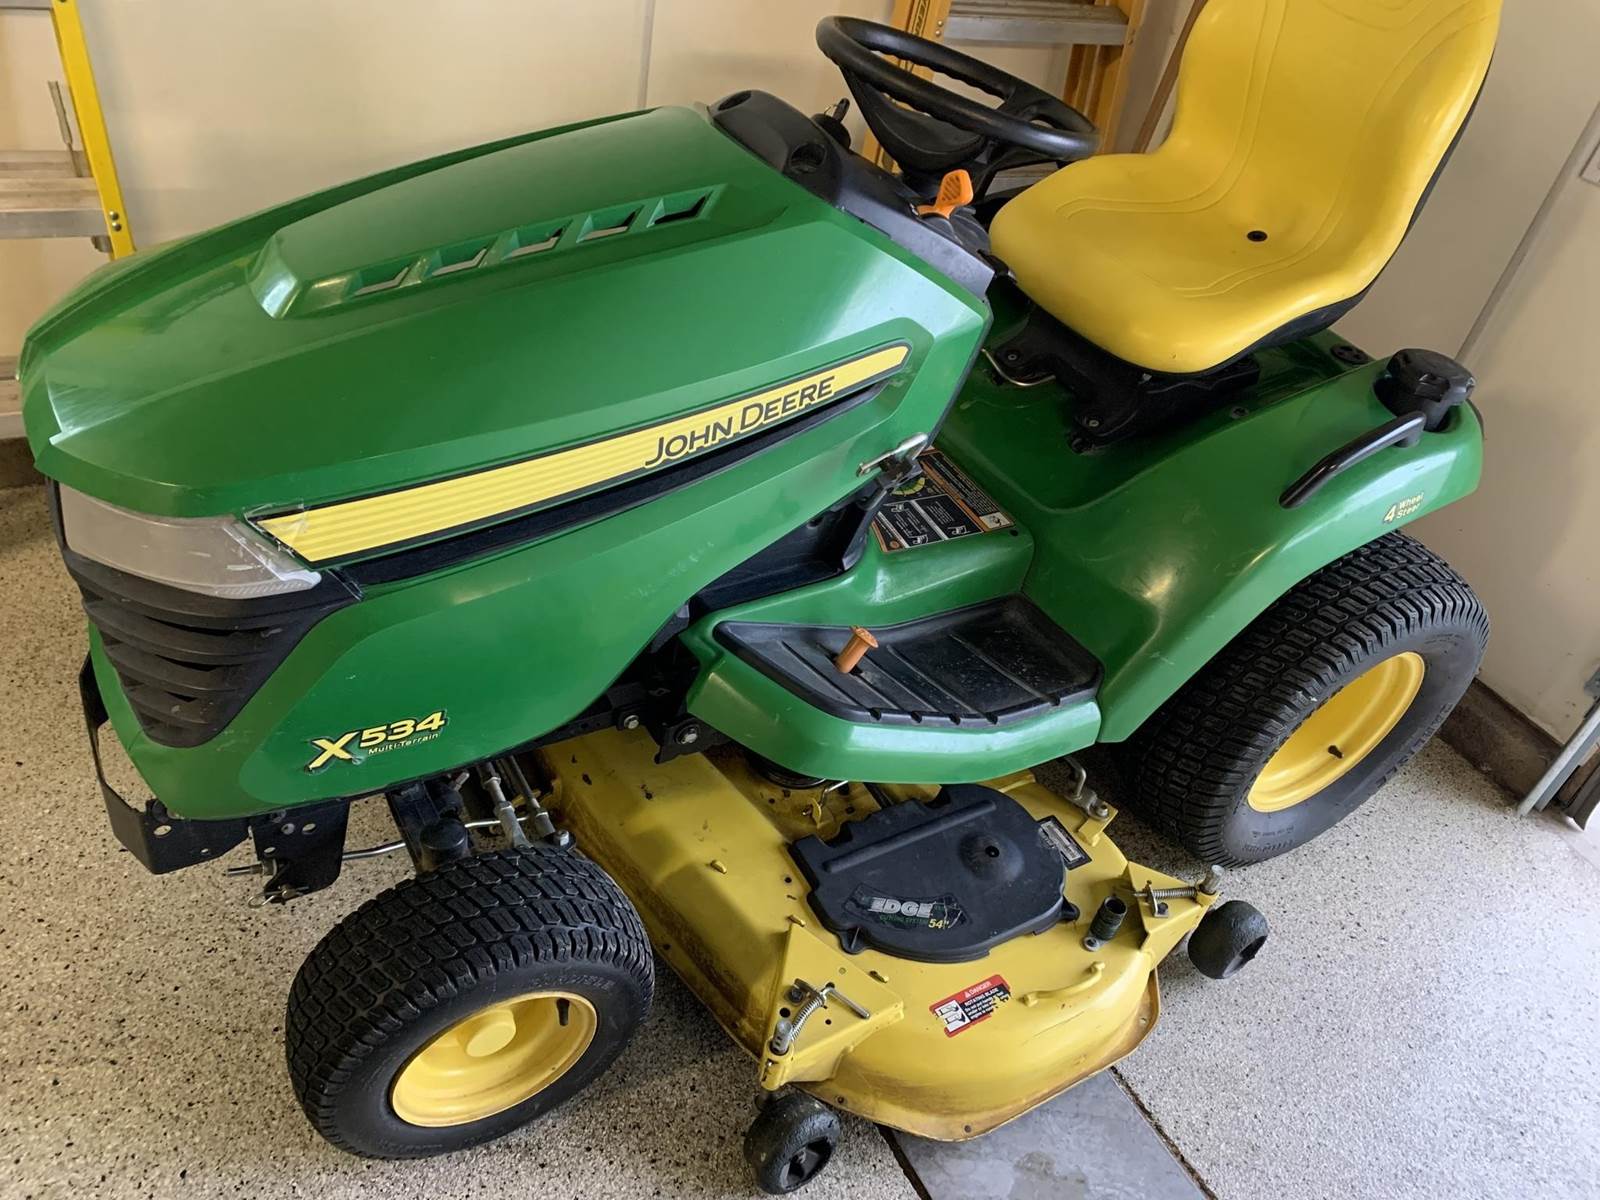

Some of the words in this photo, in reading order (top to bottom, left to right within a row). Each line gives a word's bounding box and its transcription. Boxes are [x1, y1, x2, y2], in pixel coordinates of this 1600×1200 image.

[645, 417, 733, 466] JOHN
[740, 376, 835, 431] DEERE
[1383, 504, 1396, 522] 4
[308, 711, 446, 769] X534
[367, 733, 439, 755] Multi-Terrain
[867, 897, 934, 918] EDGE
[964, 995, 984, 1006] ROTATING
[984, 988, 998, 996] BLADE
[968, 981, 992, 994] DANGER
